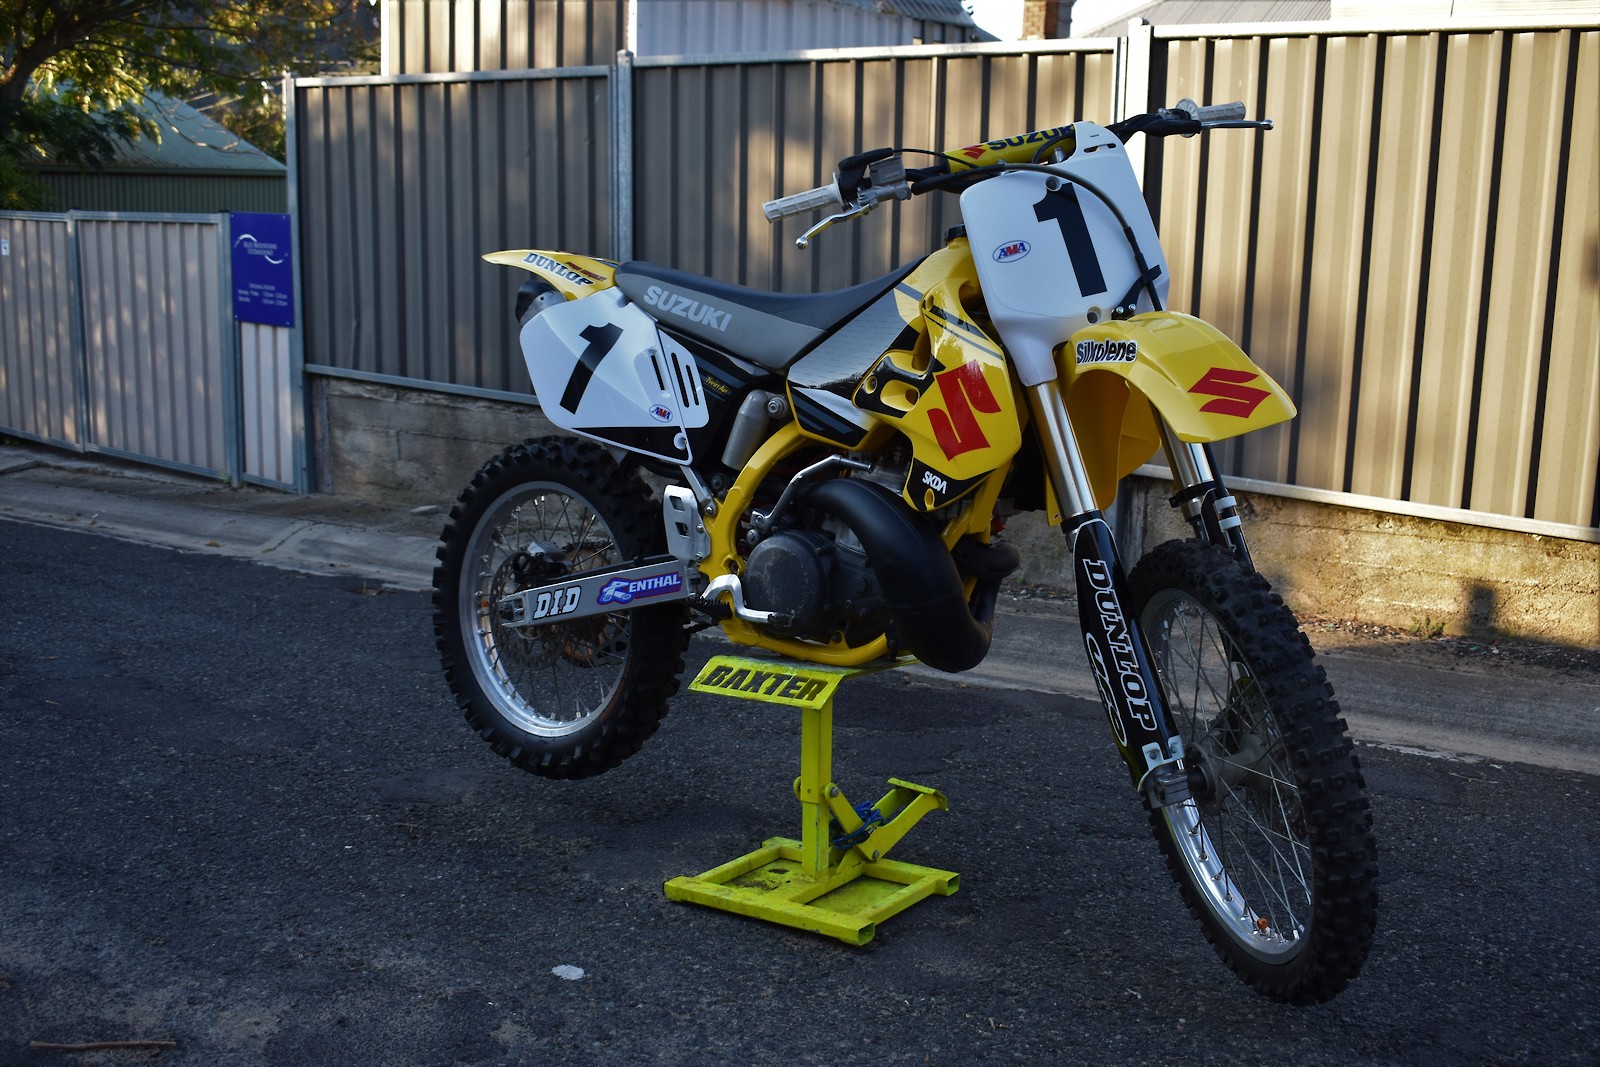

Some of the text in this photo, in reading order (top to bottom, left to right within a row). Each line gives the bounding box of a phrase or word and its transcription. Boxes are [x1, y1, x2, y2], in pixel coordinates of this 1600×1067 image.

[987, 124, 1075, 150] SUZUK
[997, 242, 1027, 260] AMA
[1033, 182, 1107, 297] 1
[523, 252, 594, 286] DUNLOP
[643, 285, 732, 332] SUZUKI
[1076, 338, 1137, 365] Silkolene
[559, 322, 624, 415] 1
[651, 406, 671, 421] AMA
[922, 470, 947, 494] SKDA
[533, 586, 581, 619] D.I.D
[1082, 558, 1157, 731] DUNLOP
[700, 665, 828, 701] BAXTER
